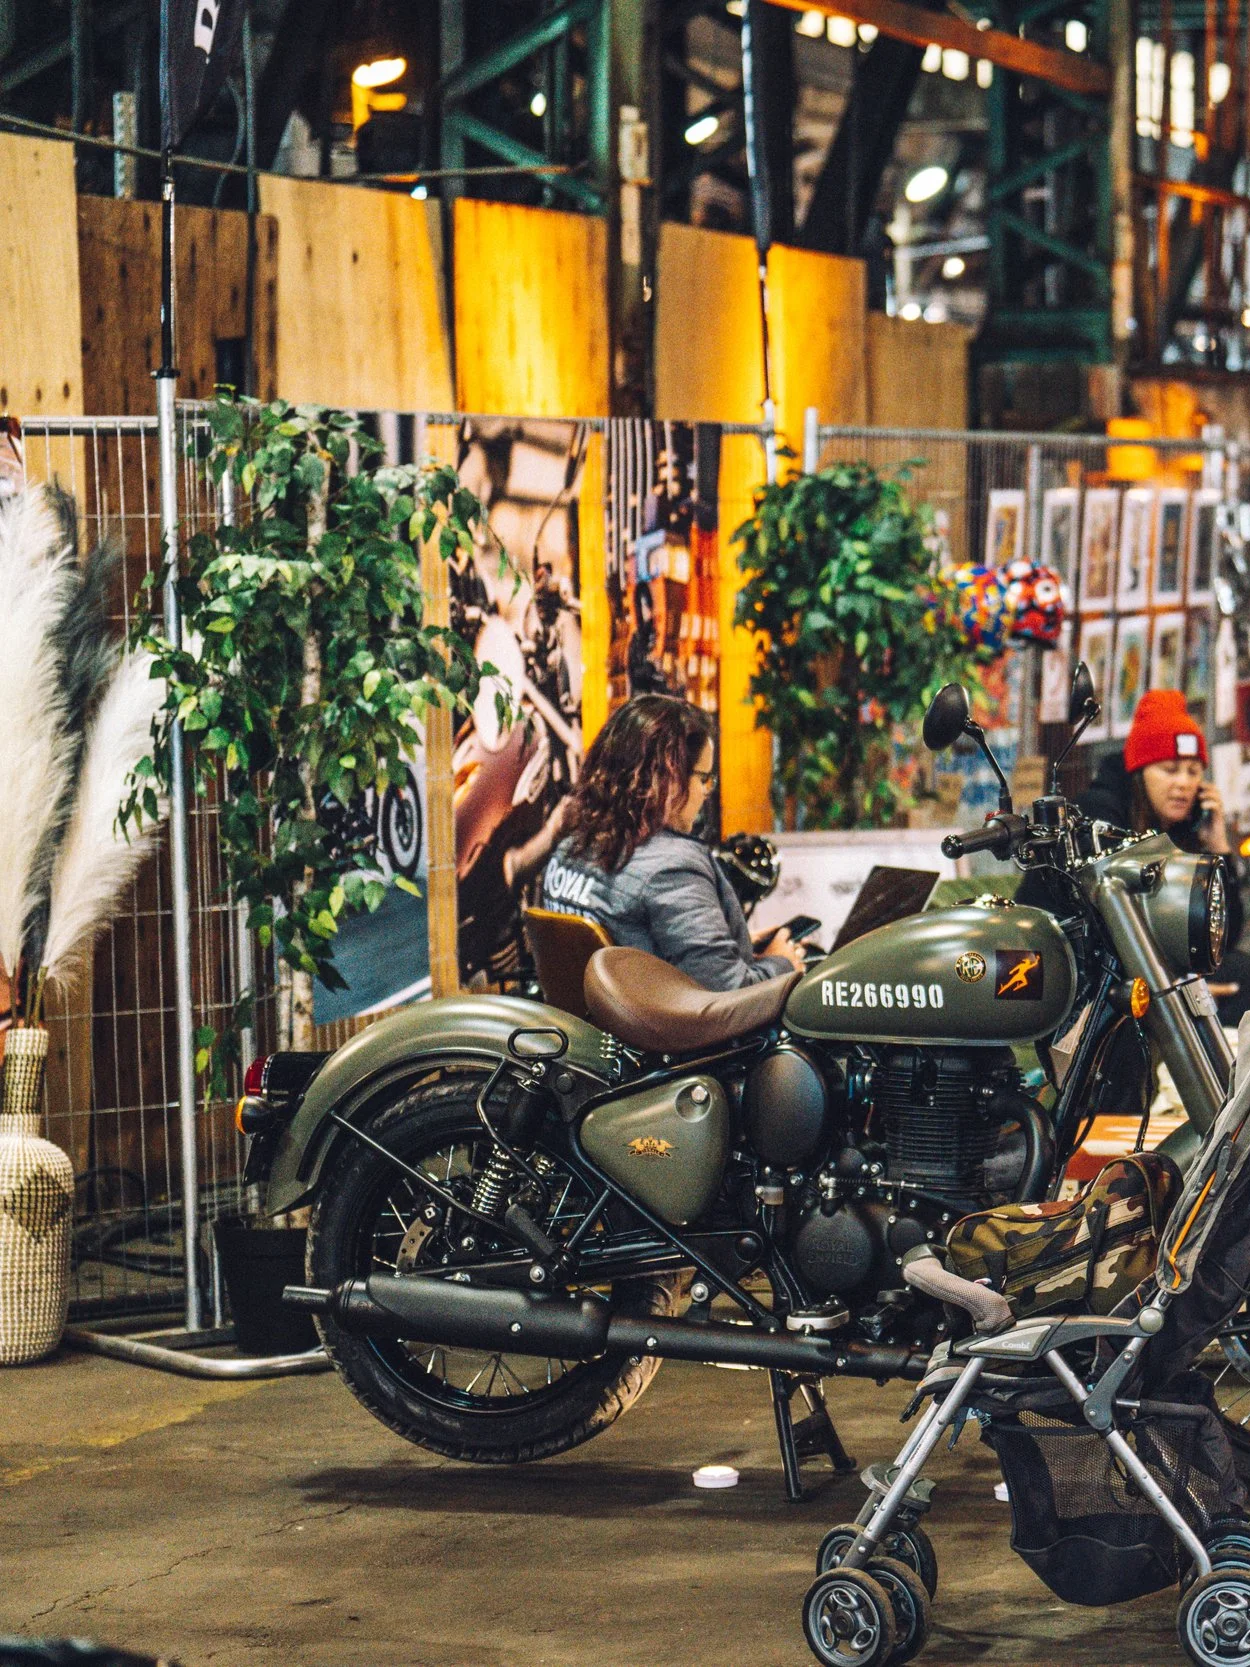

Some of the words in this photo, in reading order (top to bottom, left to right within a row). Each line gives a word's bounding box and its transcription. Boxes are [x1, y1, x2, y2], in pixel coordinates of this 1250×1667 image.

[543, 857, 604, 909] ROYAL
[821, 980, 944, 1008] RE266990
[1001, 1341, 1031, 1349] Combi
